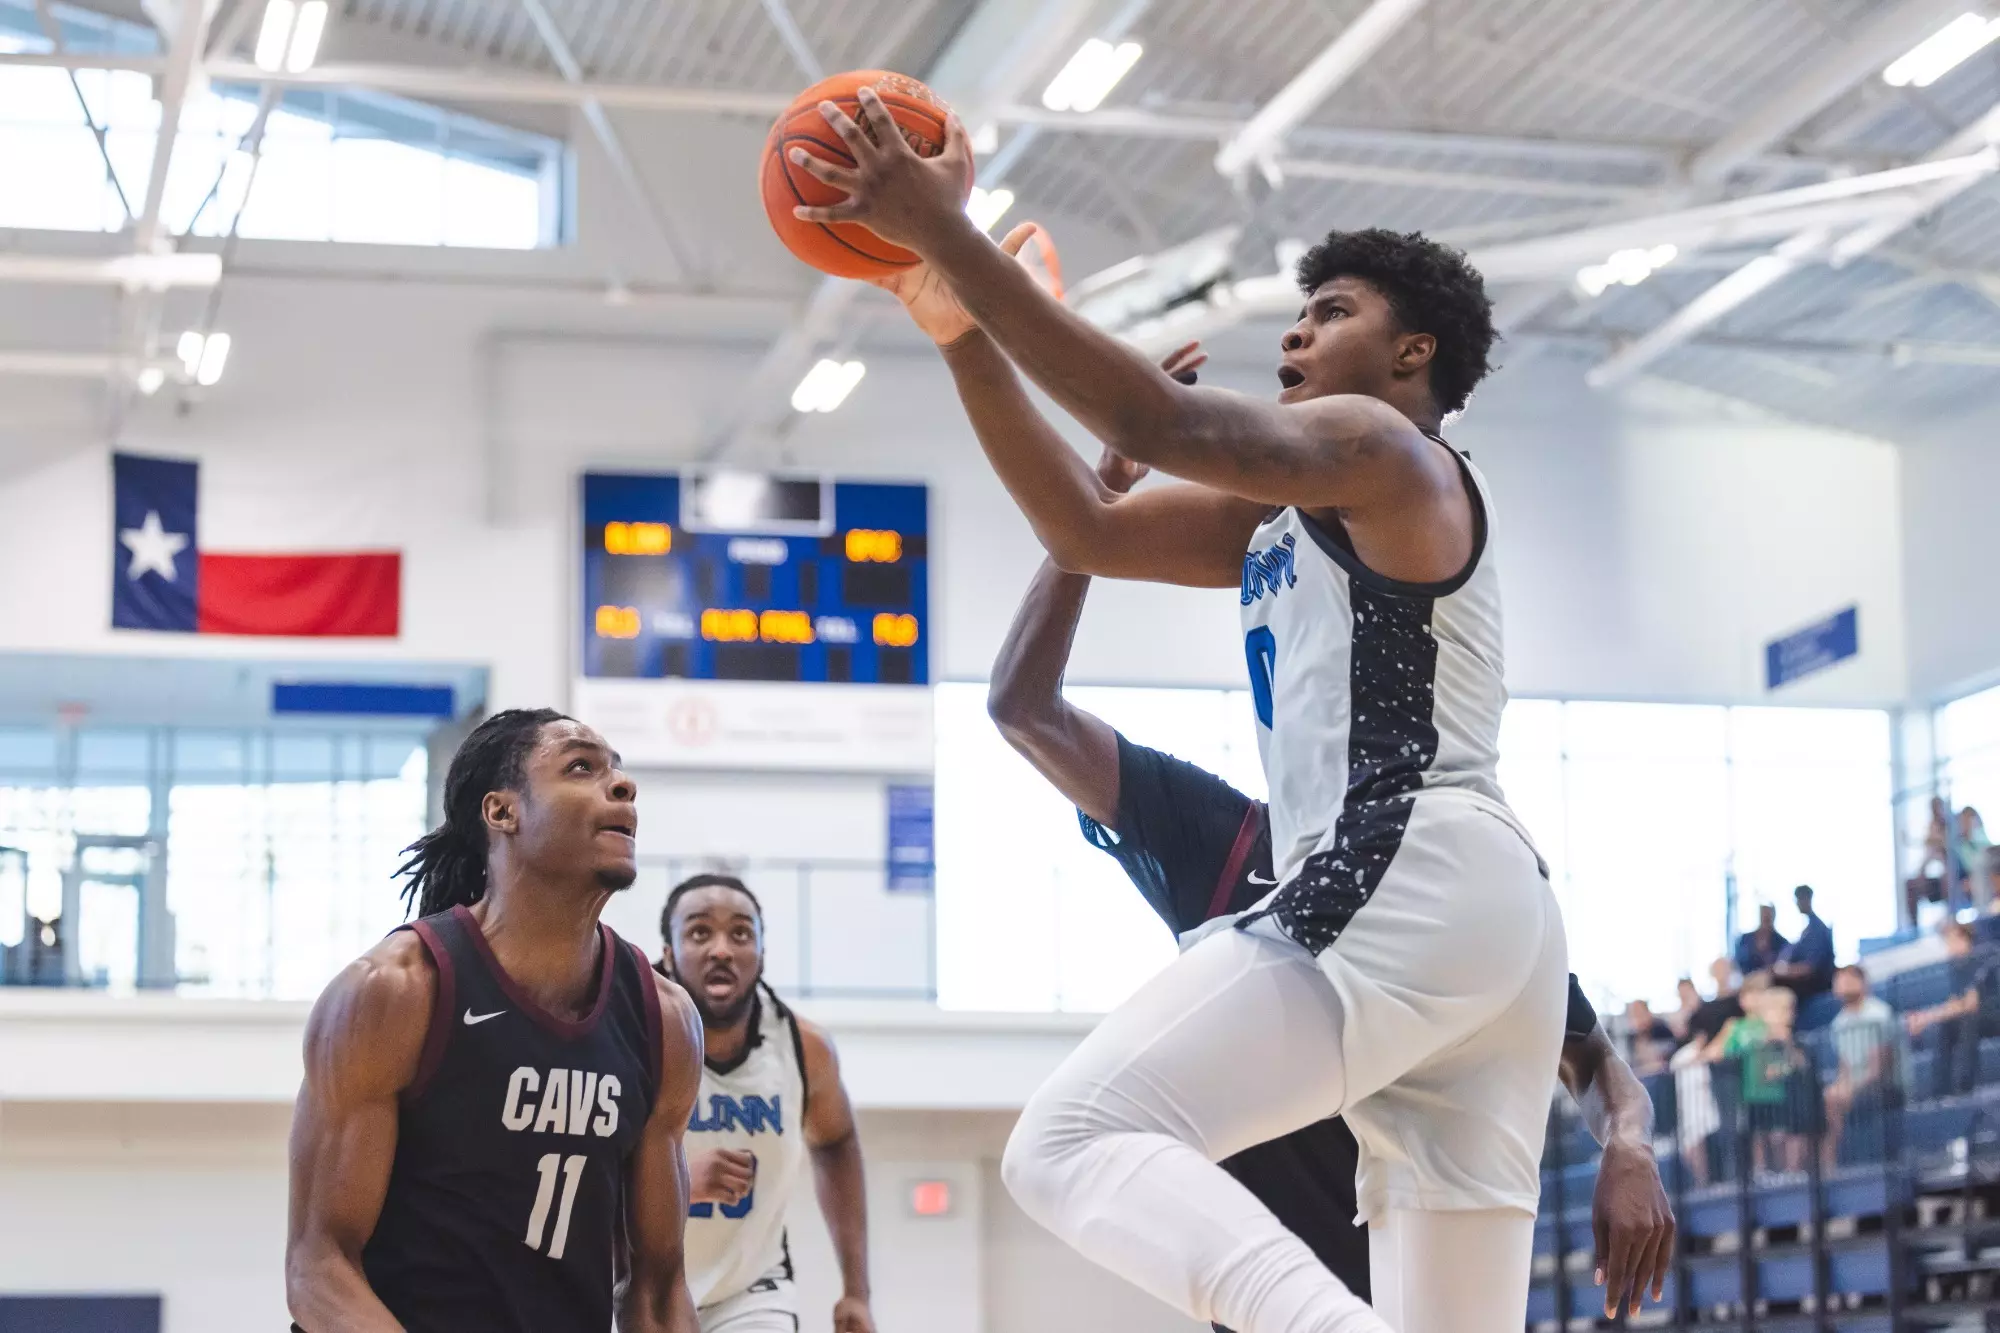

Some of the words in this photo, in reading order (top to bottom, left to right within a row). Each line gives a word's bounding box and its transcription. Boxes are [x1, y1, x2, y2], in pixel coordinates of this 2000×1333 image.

[1245, 624, 1276, 732] 0
[501, 1066, 622, 1138] CAVS
[687, 1094, 784, 1136] LINN
[522, 1153, 588, 1260] 11
